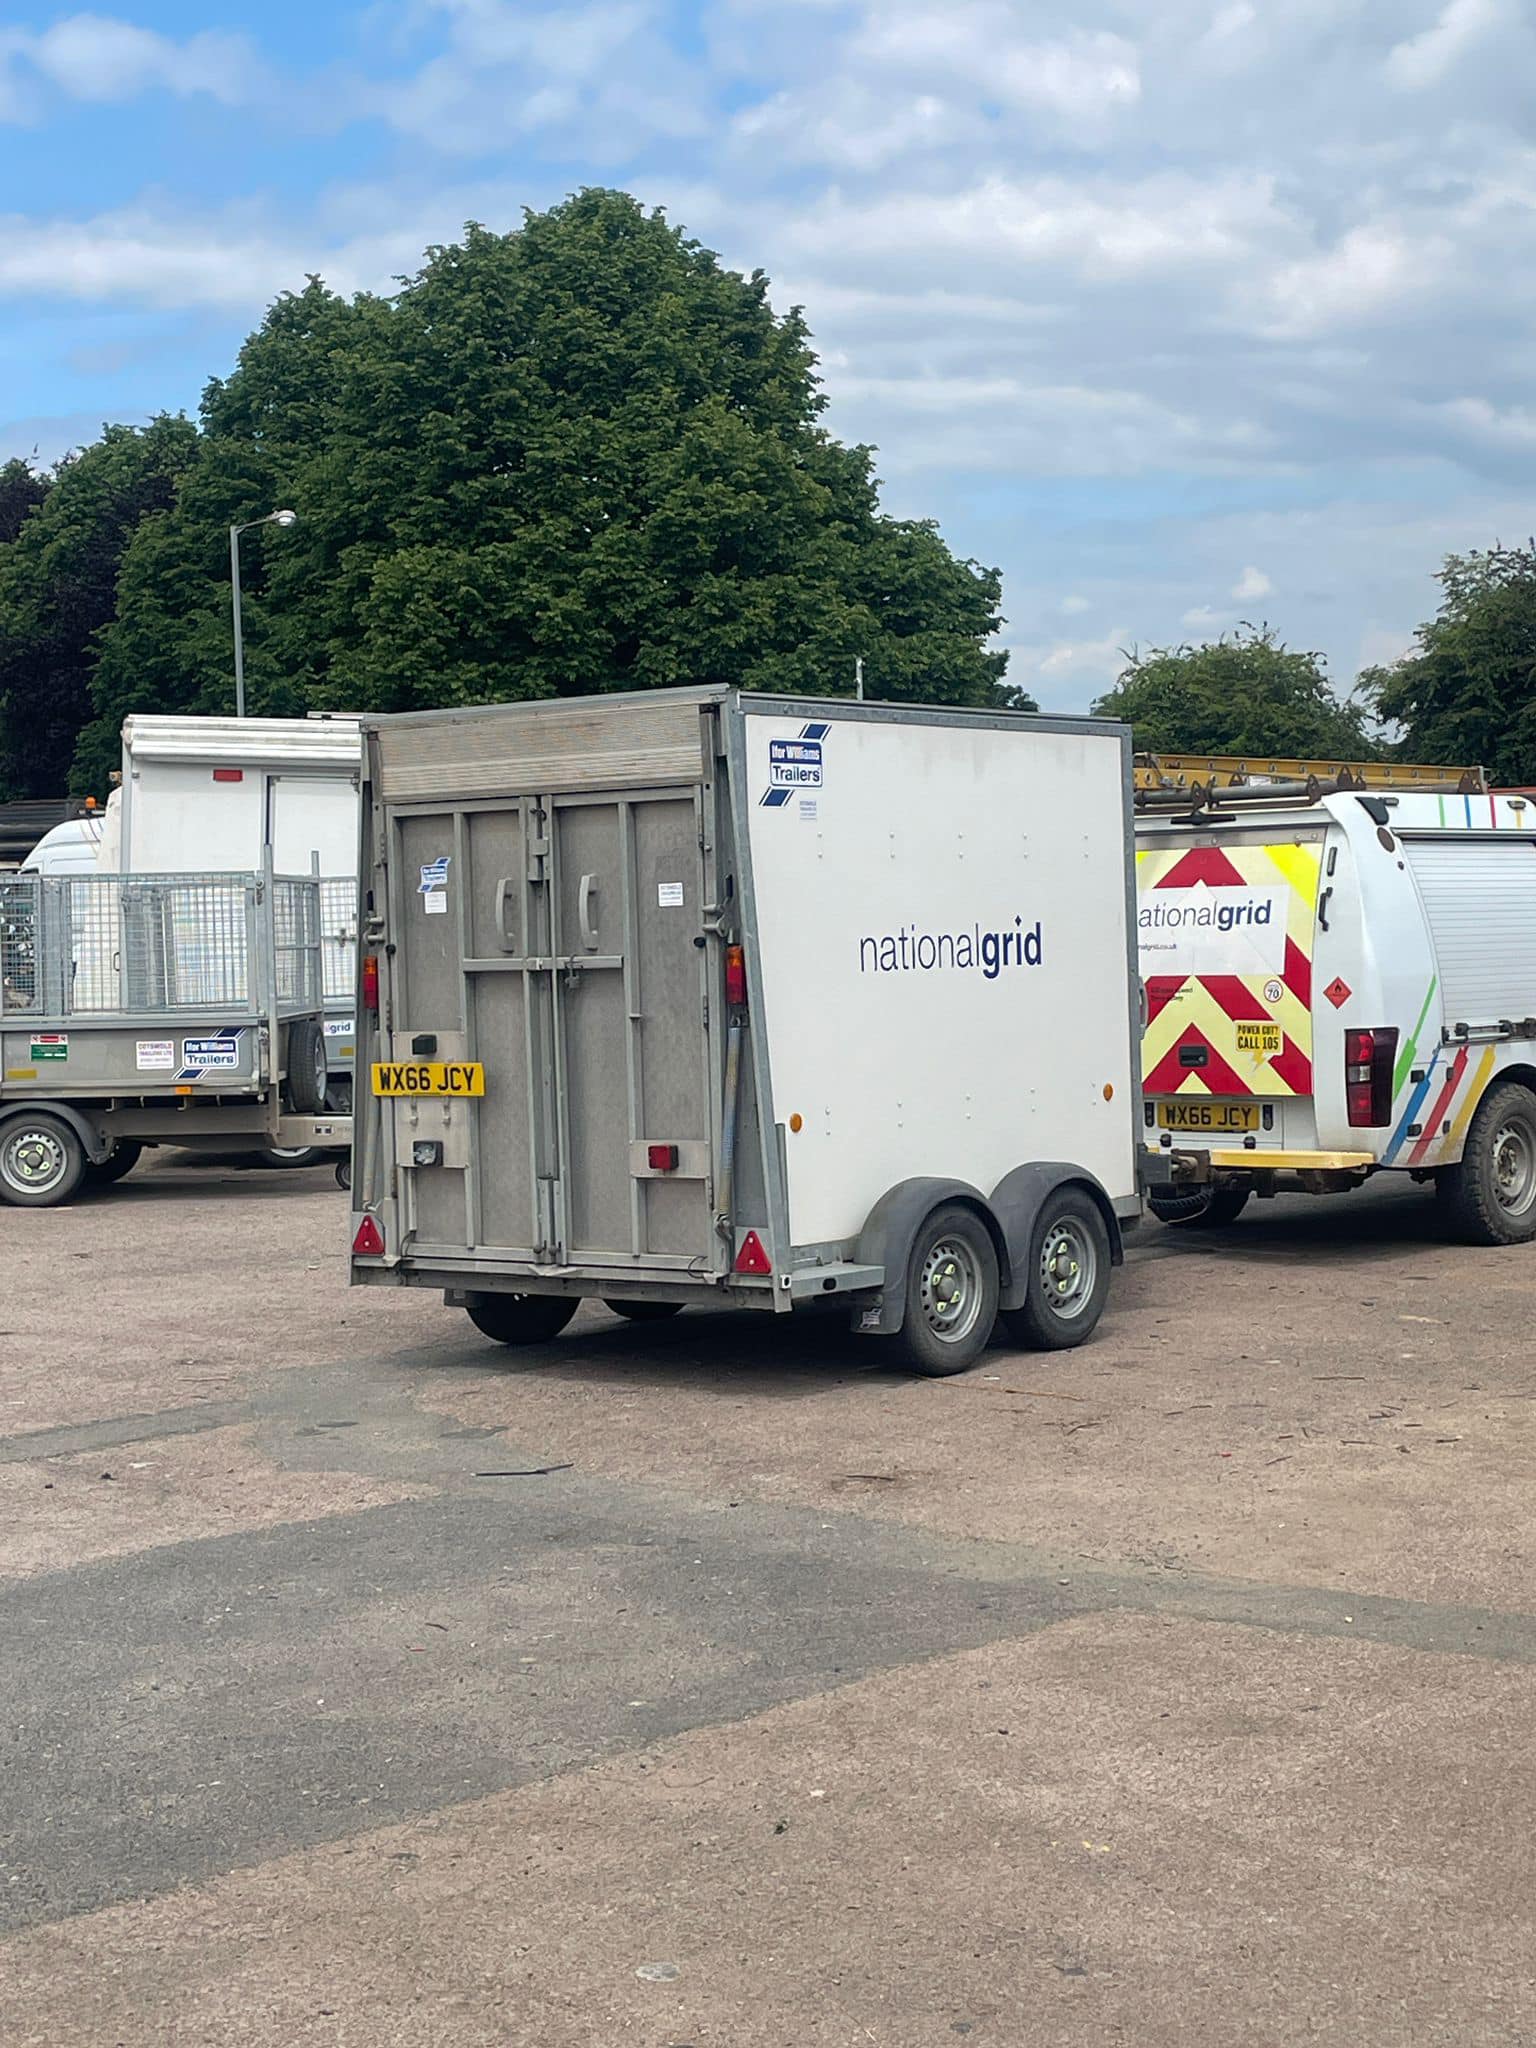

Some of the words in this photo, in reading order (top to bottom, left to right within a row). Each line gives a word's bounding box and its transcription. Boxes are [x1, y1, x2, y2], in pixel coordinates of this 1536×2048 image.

[772, 765, 820, 782] Trailers
[1138, 899, 1272, 931] ationalgrid
[860, 915, 1042, 979] nationalgrid
[1267, 989, 1280, 999] 70
[1238, 1025, 1260, 1035] POWER
[1238, 1037, 1260, 1049] CALL
[1262, 1037, 1279, 1049] 105
[187, 1054, 234, 1064] Trailers
[379, 1067, 431, 1091] WX66
[437, 1067, 475, 1092] JCY
[1165, 1106, 1212, 1125] WX66
[1217, 1107, 1252, 1127] JCY
